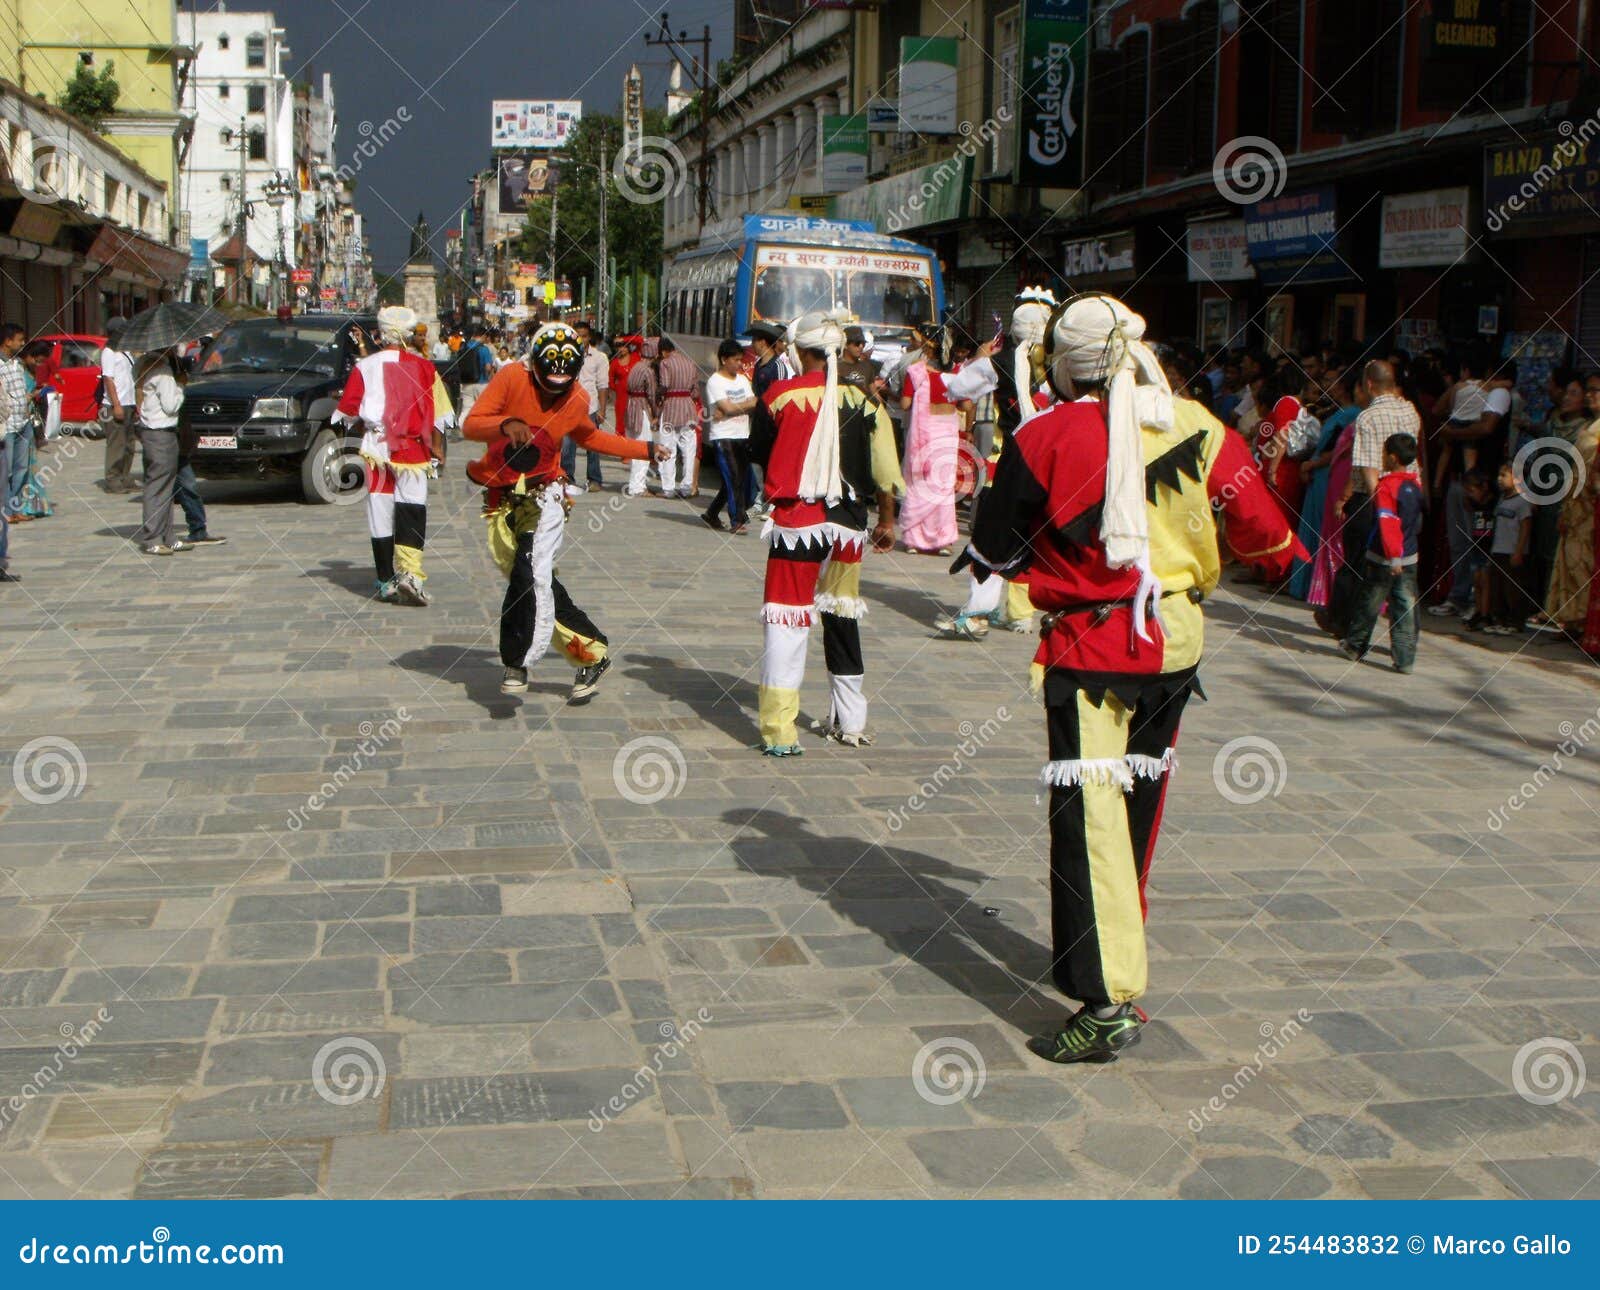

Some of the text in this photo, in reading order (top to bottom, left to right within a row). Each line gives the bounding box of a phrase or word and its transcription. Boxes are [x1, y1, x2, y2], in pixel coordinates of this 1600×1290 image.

[1436, 22, 1496, 48] CLEANERS
[1029, 41, 1077, 166] Carlsberg
[1494, 147, 1542, 176] BAND
